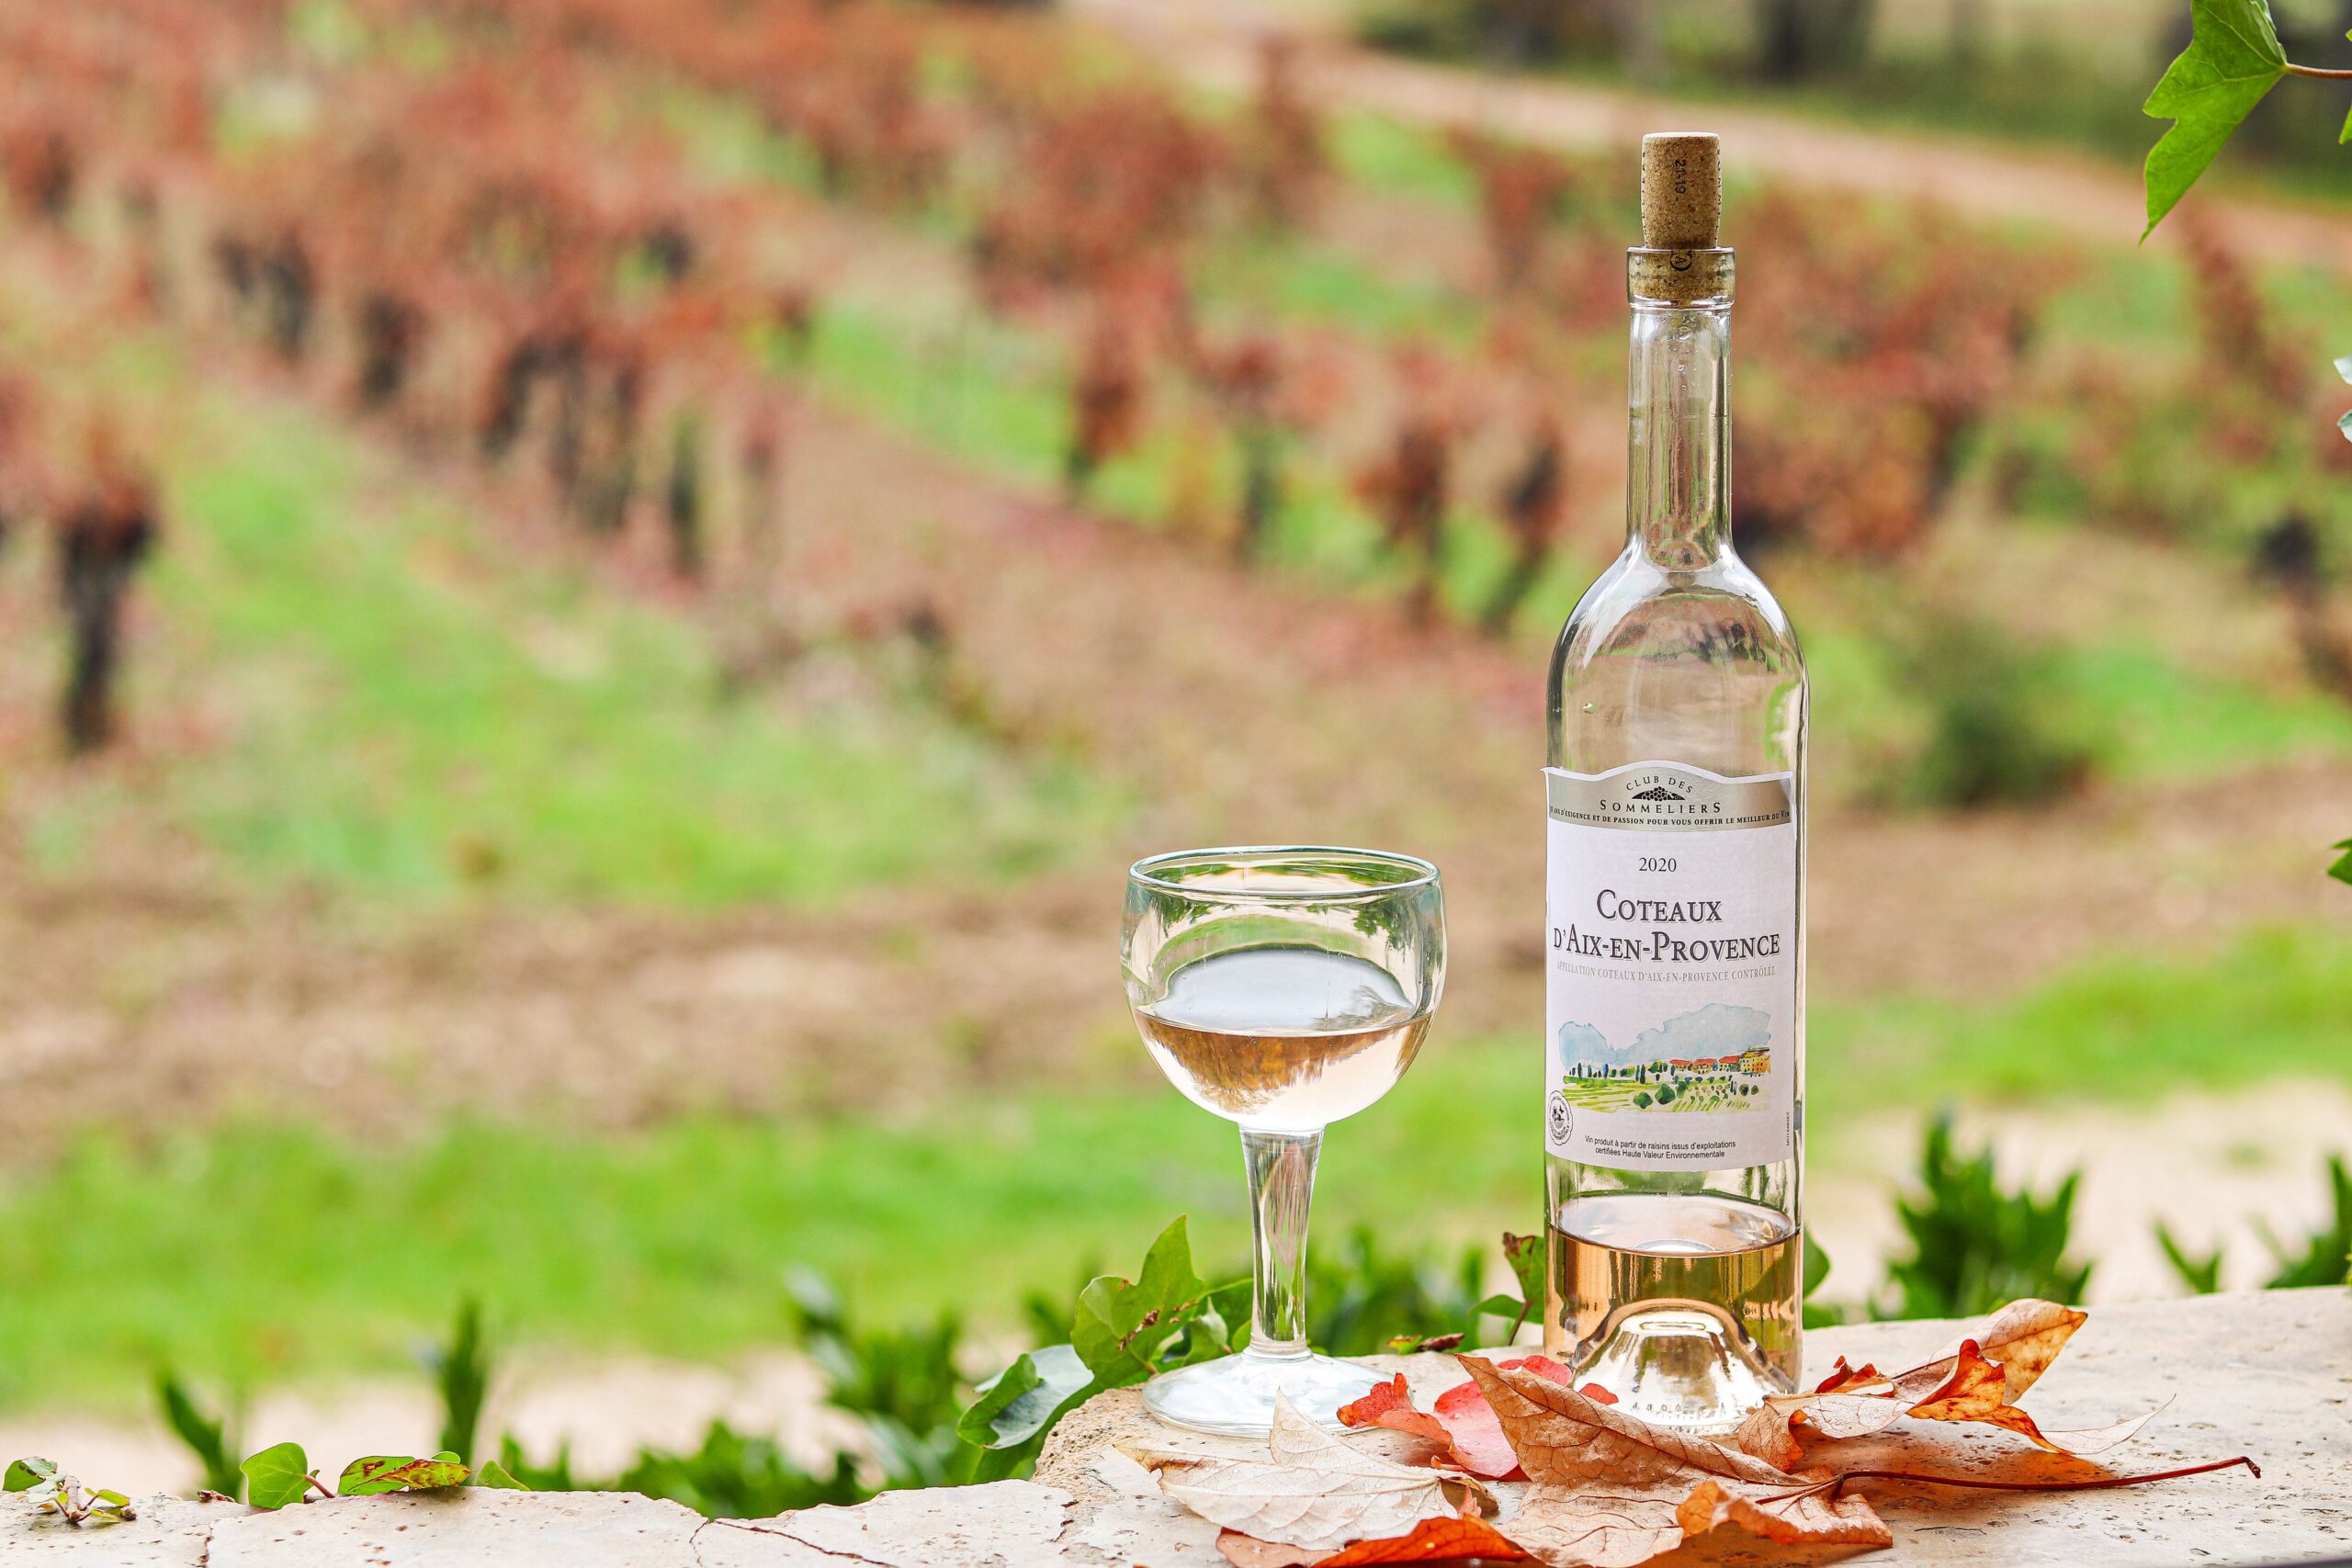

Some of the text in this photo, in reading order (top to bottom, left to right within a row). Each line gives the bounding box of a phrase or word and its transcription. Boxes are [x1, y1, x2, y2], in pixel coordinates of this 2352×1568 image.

[1626, 775, 1693, 794] CLUB DES
[1600, 799, 1721, 814] SOMMELIERS
[1613, 817, 1645, 825] PASSION
[1736, 814, 1770, 824] MEILLEUR
[1771, 812, 1780, 820] DU
[1638, 857, 1677, 873] 2020
[1596, 888, 1723, 922] COTEAUX
[1557, 961, 1776, 982] APPELLATION COTEAUX D'AIX-EN-PROVENCE CONTRÔLÉE
[1585, 1135, 1593, 1144] Vin
[1594, 1138, 1613, 1146] produit
[1620, 1141, 1636, 1149] partir
[1647, 1142, 1670, 1150] raisins
[1671, 1142, 1689, 1150] issus
[1690, 1141, 1736, 1151] d'exploitations
[1595, 1147, 1725, 1159] certifiées Haute Valeur Environnementale
